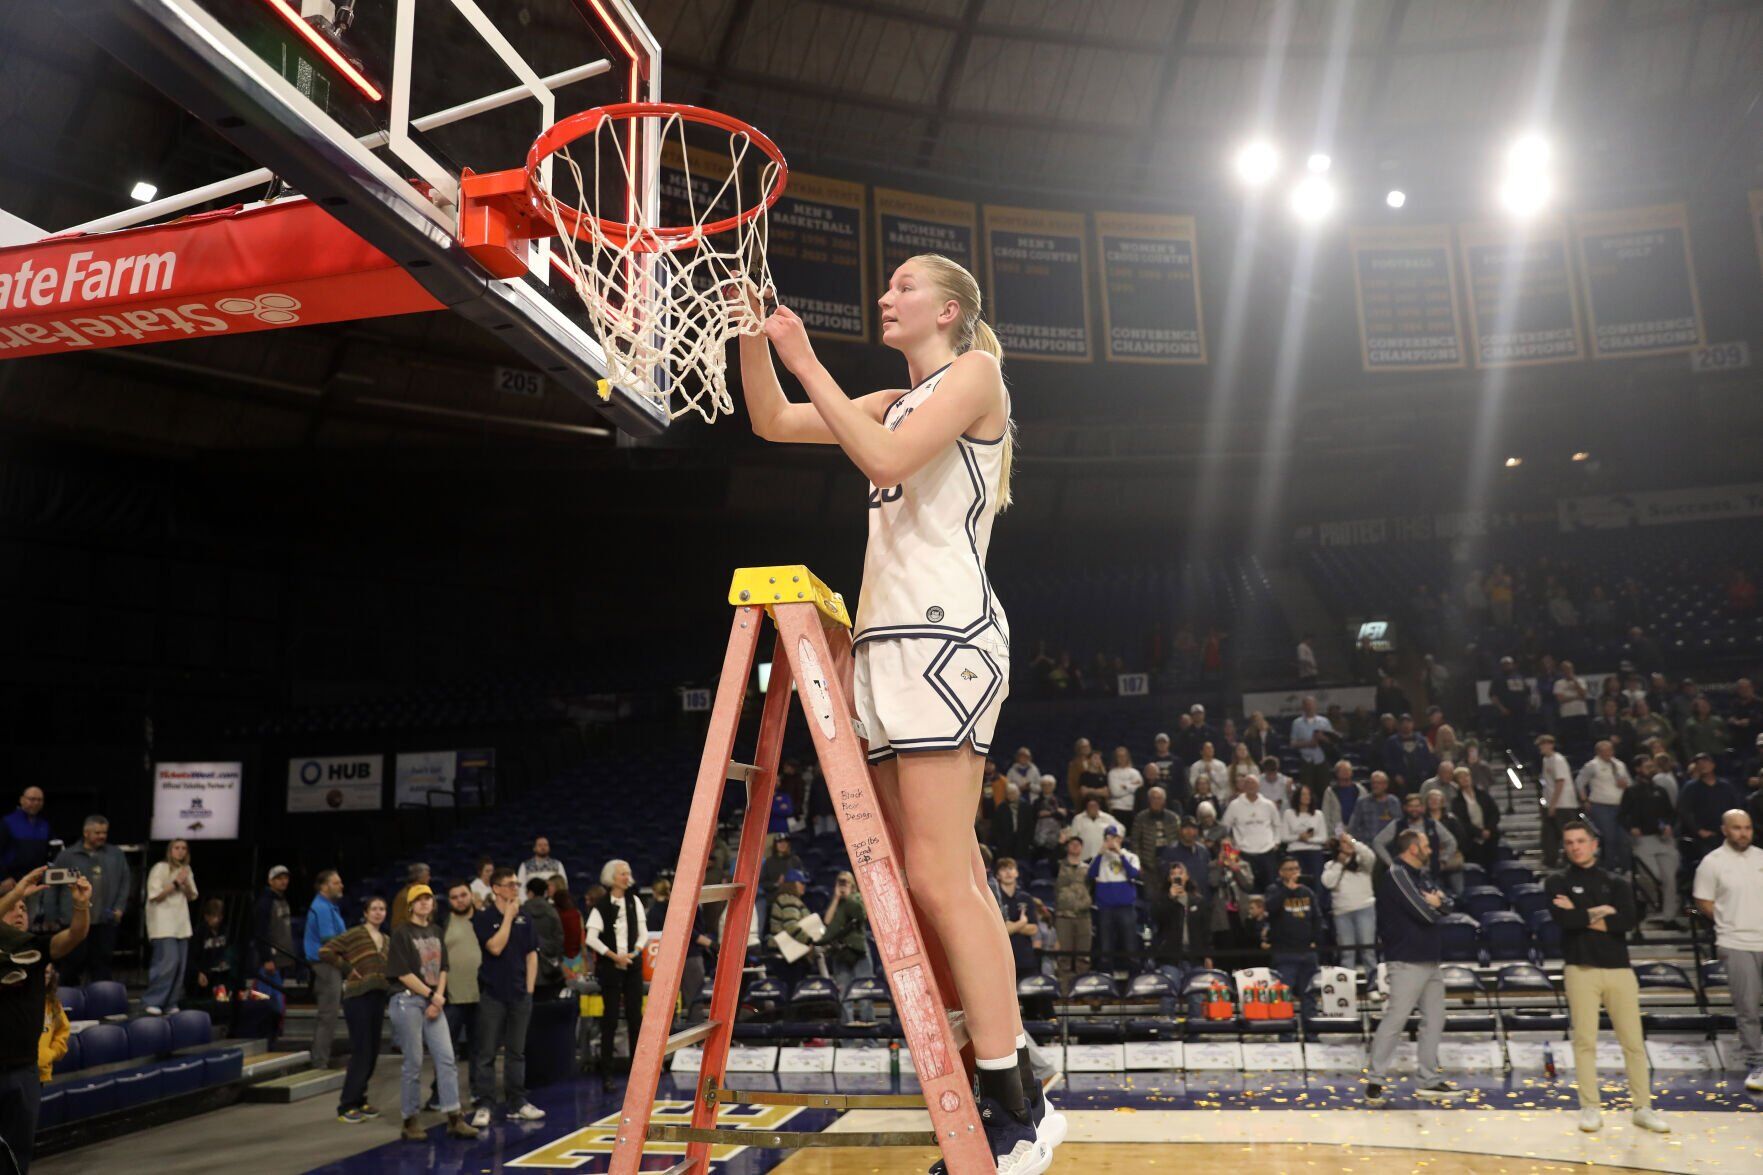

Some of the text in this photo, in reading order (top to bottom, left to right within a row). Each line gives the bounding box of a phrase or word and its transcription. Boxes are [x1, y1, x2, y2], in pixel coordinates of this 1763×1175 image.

[793, 203, 833, 220] MEN'S
[773, 212, 854, 235] BASKETBALL
[778, 295, 861, 316] ONFERENCE
[502, 370, 538, 393] 205
[1123, 676, 1144, 692] 107
[328, 762, 371, 781] HUB
[841, 788, 864, 801] Black
[845, 811, 873, 821] Design
